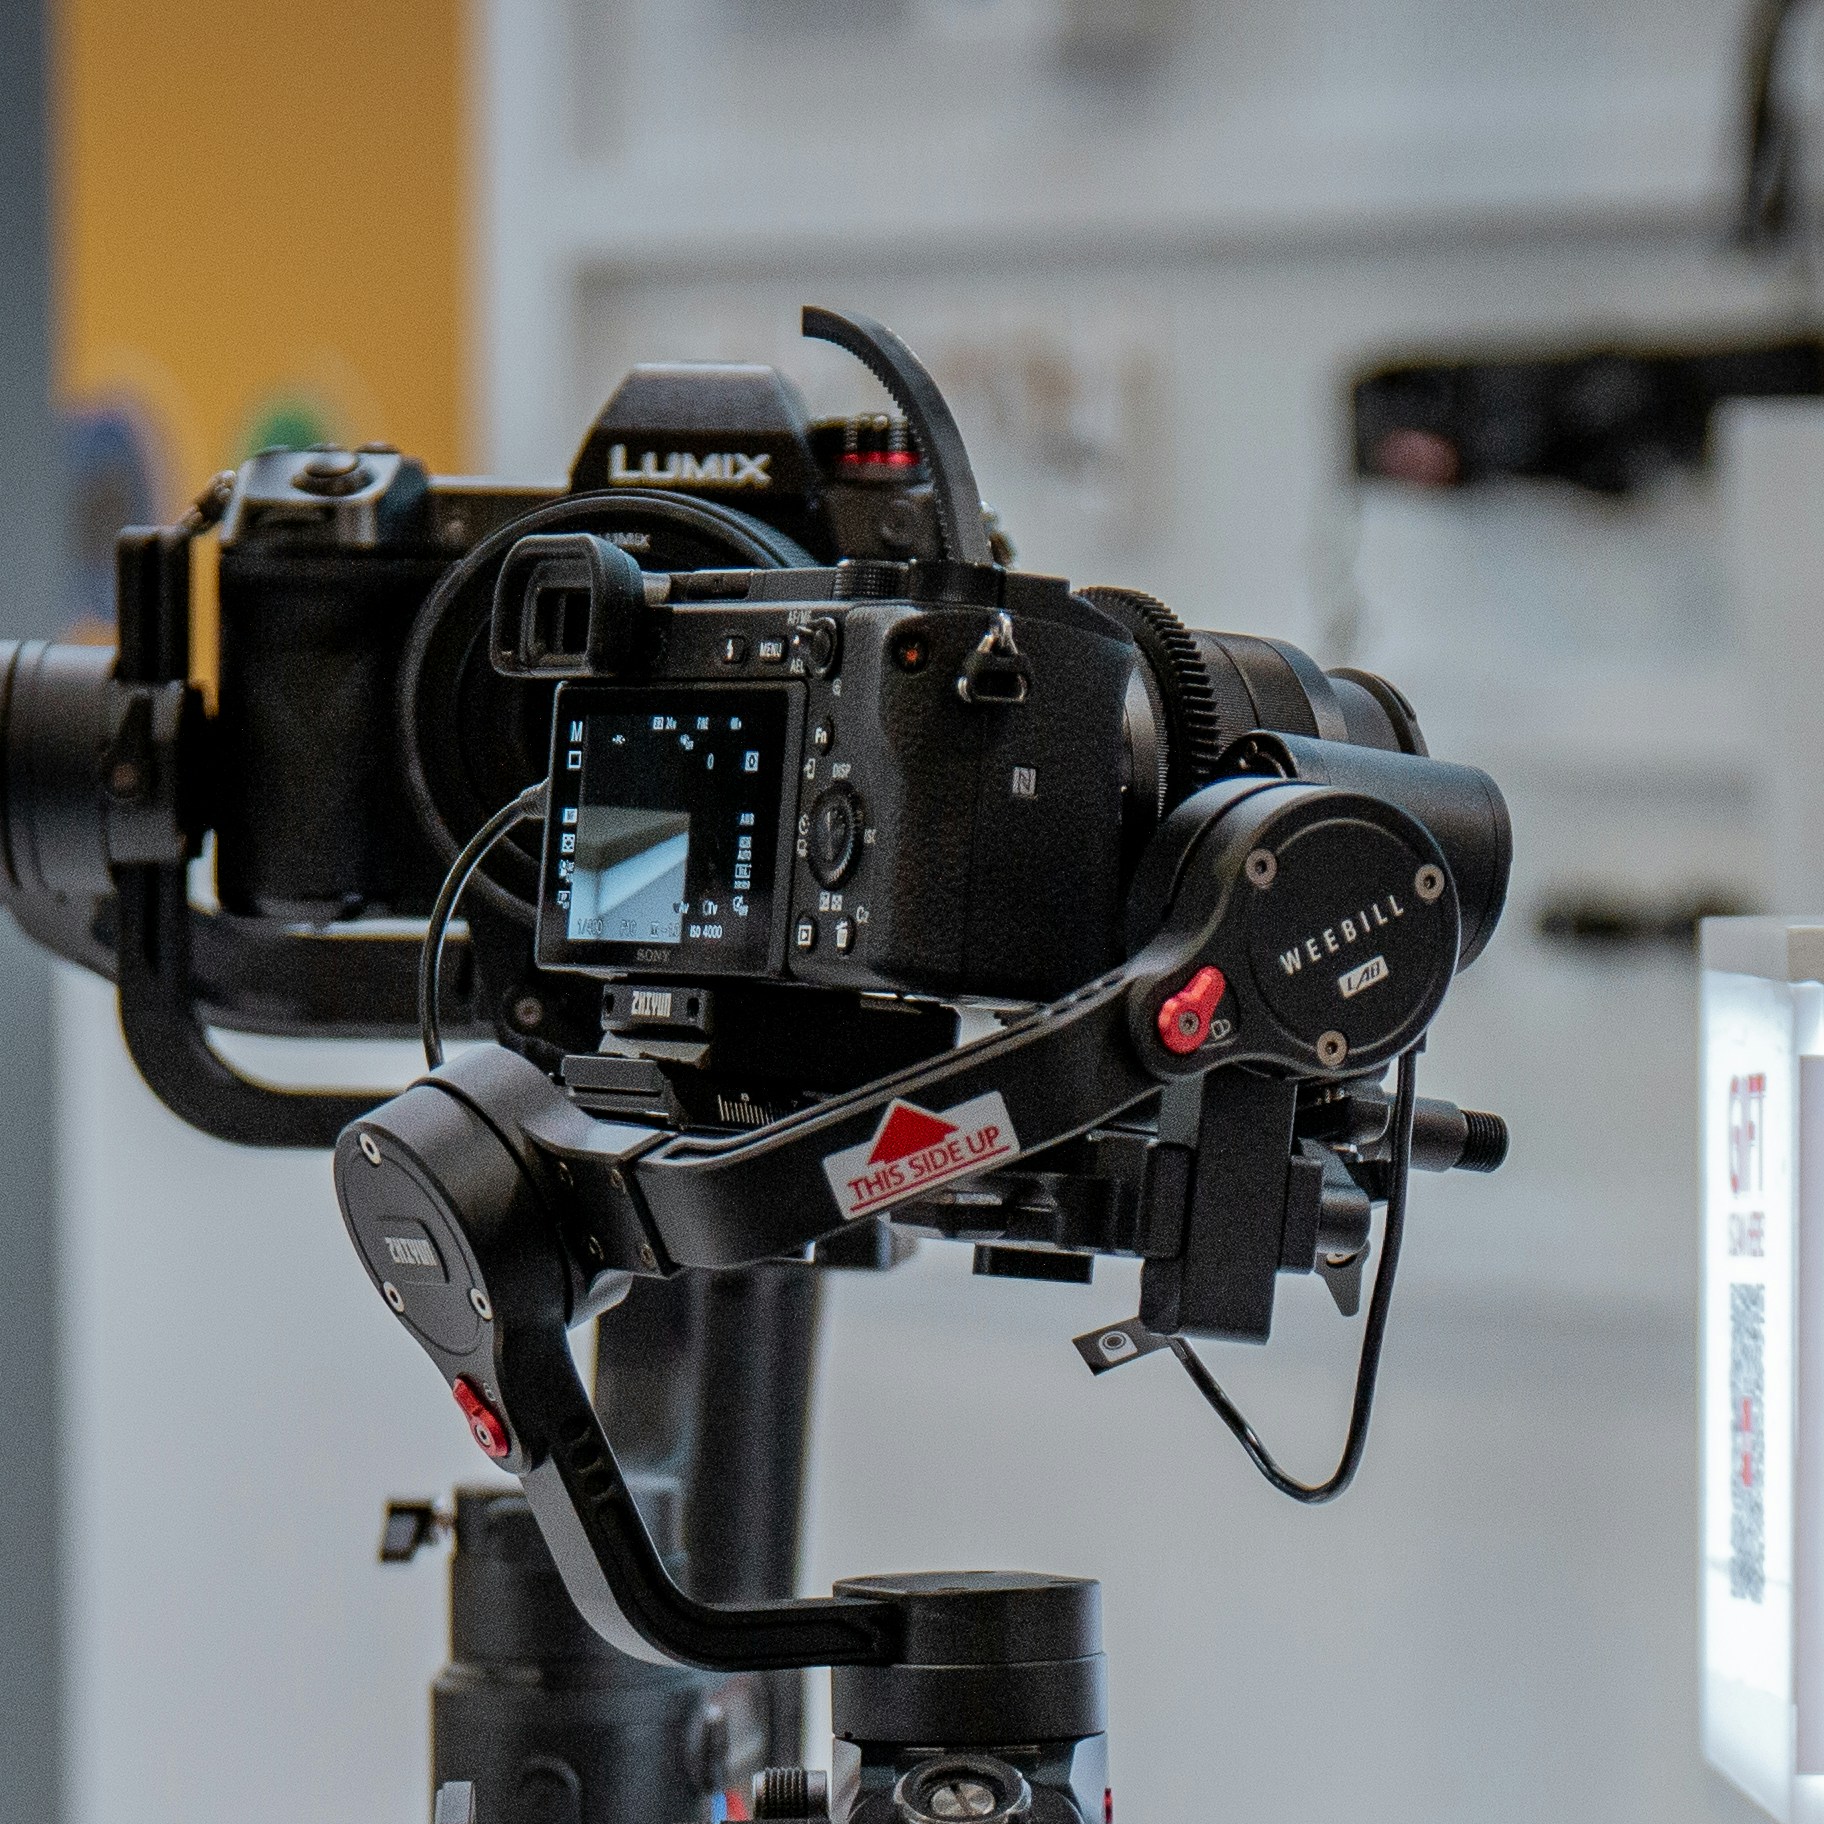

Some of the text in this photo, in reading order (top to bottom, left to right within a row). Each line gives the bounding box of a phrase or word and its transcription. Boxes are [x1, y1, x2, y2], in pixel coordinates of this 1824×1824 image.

[608, 443, 772, 487] LUMIX
[759, 642, 782, 657] MENU
[570, 720, 583, 742] M
[815, 727, 827, 744] Fn
[689, 924, 701, 938] ISO
[1280, 895, 1405, 976] WEEBILL
[636, 949, 672, 963] SONY
[1344, 961, 1385, 993] LAB
[631, 990, 672, 1018] ZHIYUN
[848, 1125, 1000, 1201] THIS SIDE UP
[384, 1237, 437, 1266] ZHIYUN
